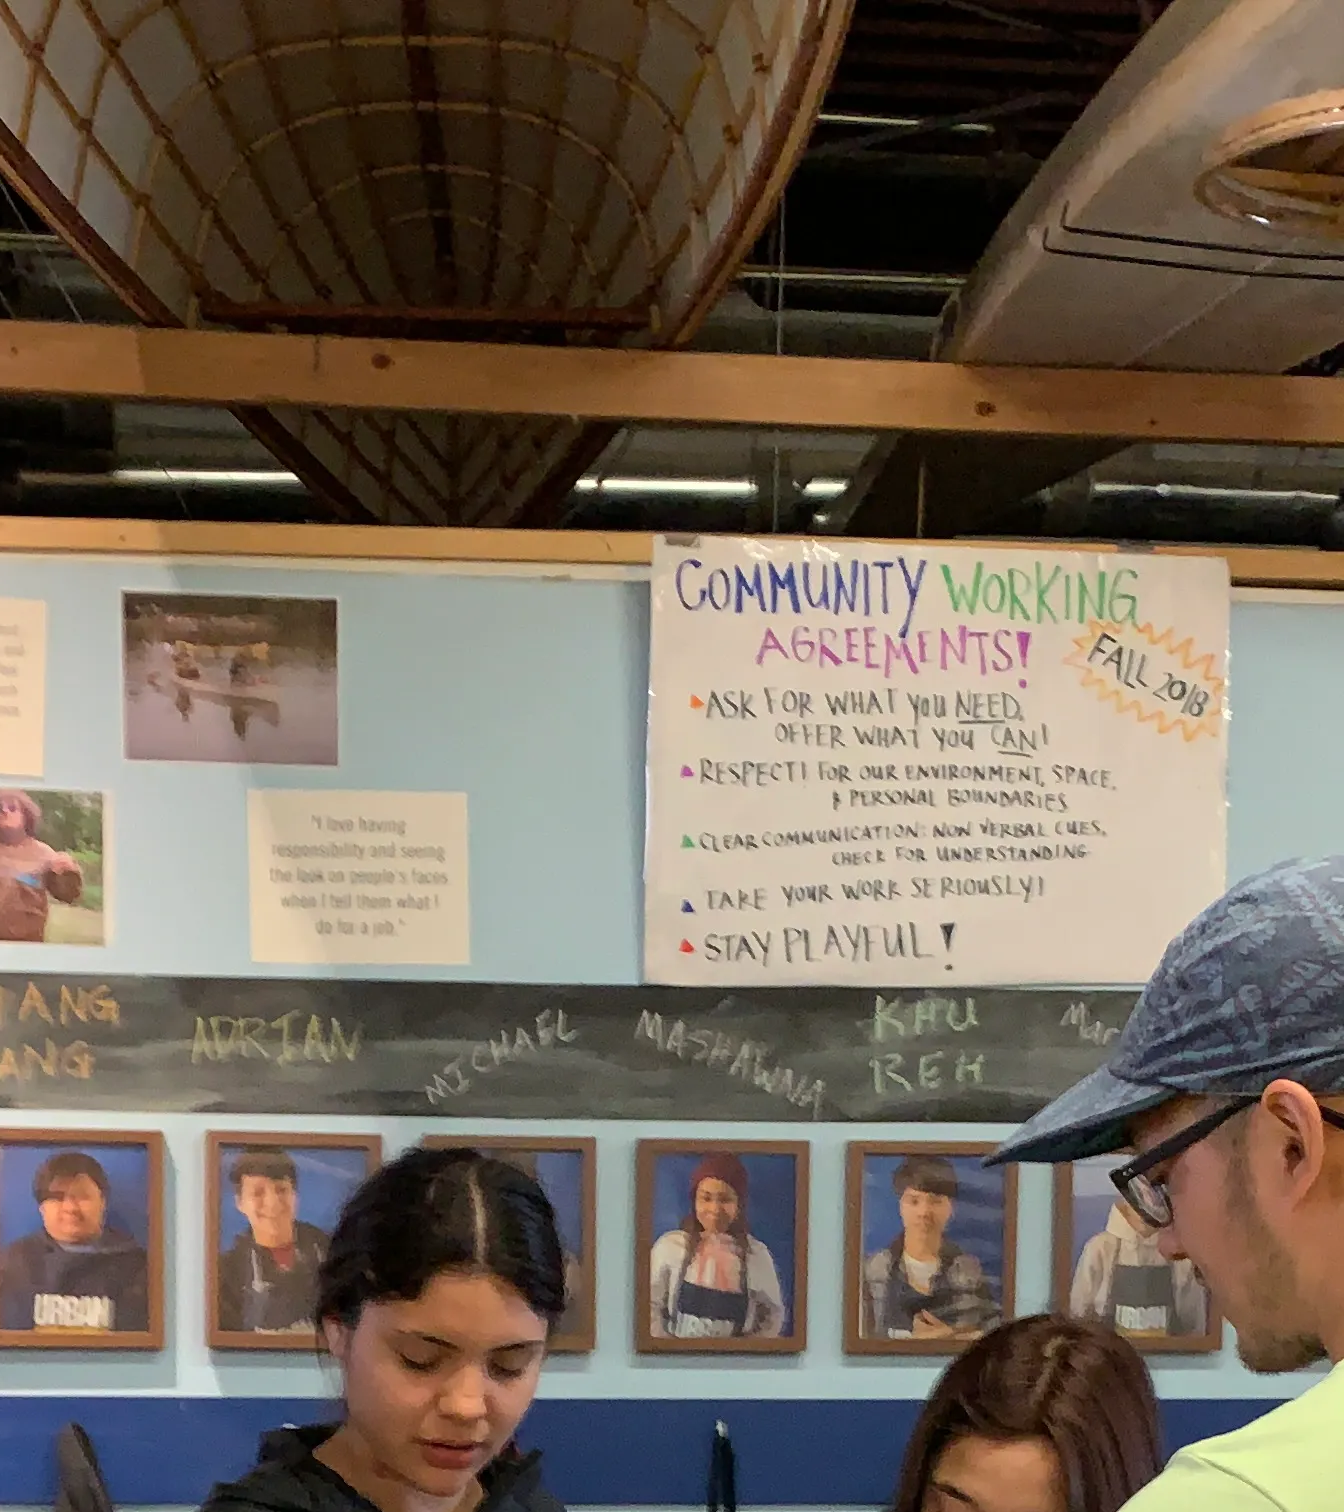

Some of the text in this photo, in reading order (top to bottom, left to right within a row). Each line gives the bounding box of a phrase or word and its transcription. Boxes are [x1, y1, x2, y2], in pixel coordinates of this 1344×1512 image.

[675, 556, 1140, 638] COMMUNITY WORKING
[756, 624, 1033, 689] AGREEMENTS!
[1086, 631, 1211, 718] FALL 2018
[706, 690, 758, 720] ASK
[764, 686, 814, 715] FOR
[824, 687, 898, 716] WHAT
[774, 722, 847, 748] OFFER
[853, 724, 920, 750] WHAT
[818, 761, 852, 783] FOR
[858, 763, 900, 782] OUR
[848, 786, 937, 809] PERSONAL
[946, 787, 1069, 813] BOUNDARIES
[271, 841, 366, 862] responsibility
[369, 842, 397, 860] and
[698, 831, 759, 853] CLEAR
[978, 818, 1048, 839] VERBAL
[831, 846, 886, 867] CHECK
[895, 845, 927, 865] FOR
[269, 867, 293, 885] the
[705, 889, 767, 913] TAKE
[781, 883, 834, 908] YOUR
[840, 876, 903, 902] WORK
[702, 930, 773, 968] STAY
[190, 1008, 364, 1066] ADRIAN
[424, 1008, 578, 1106] MICHAEL
